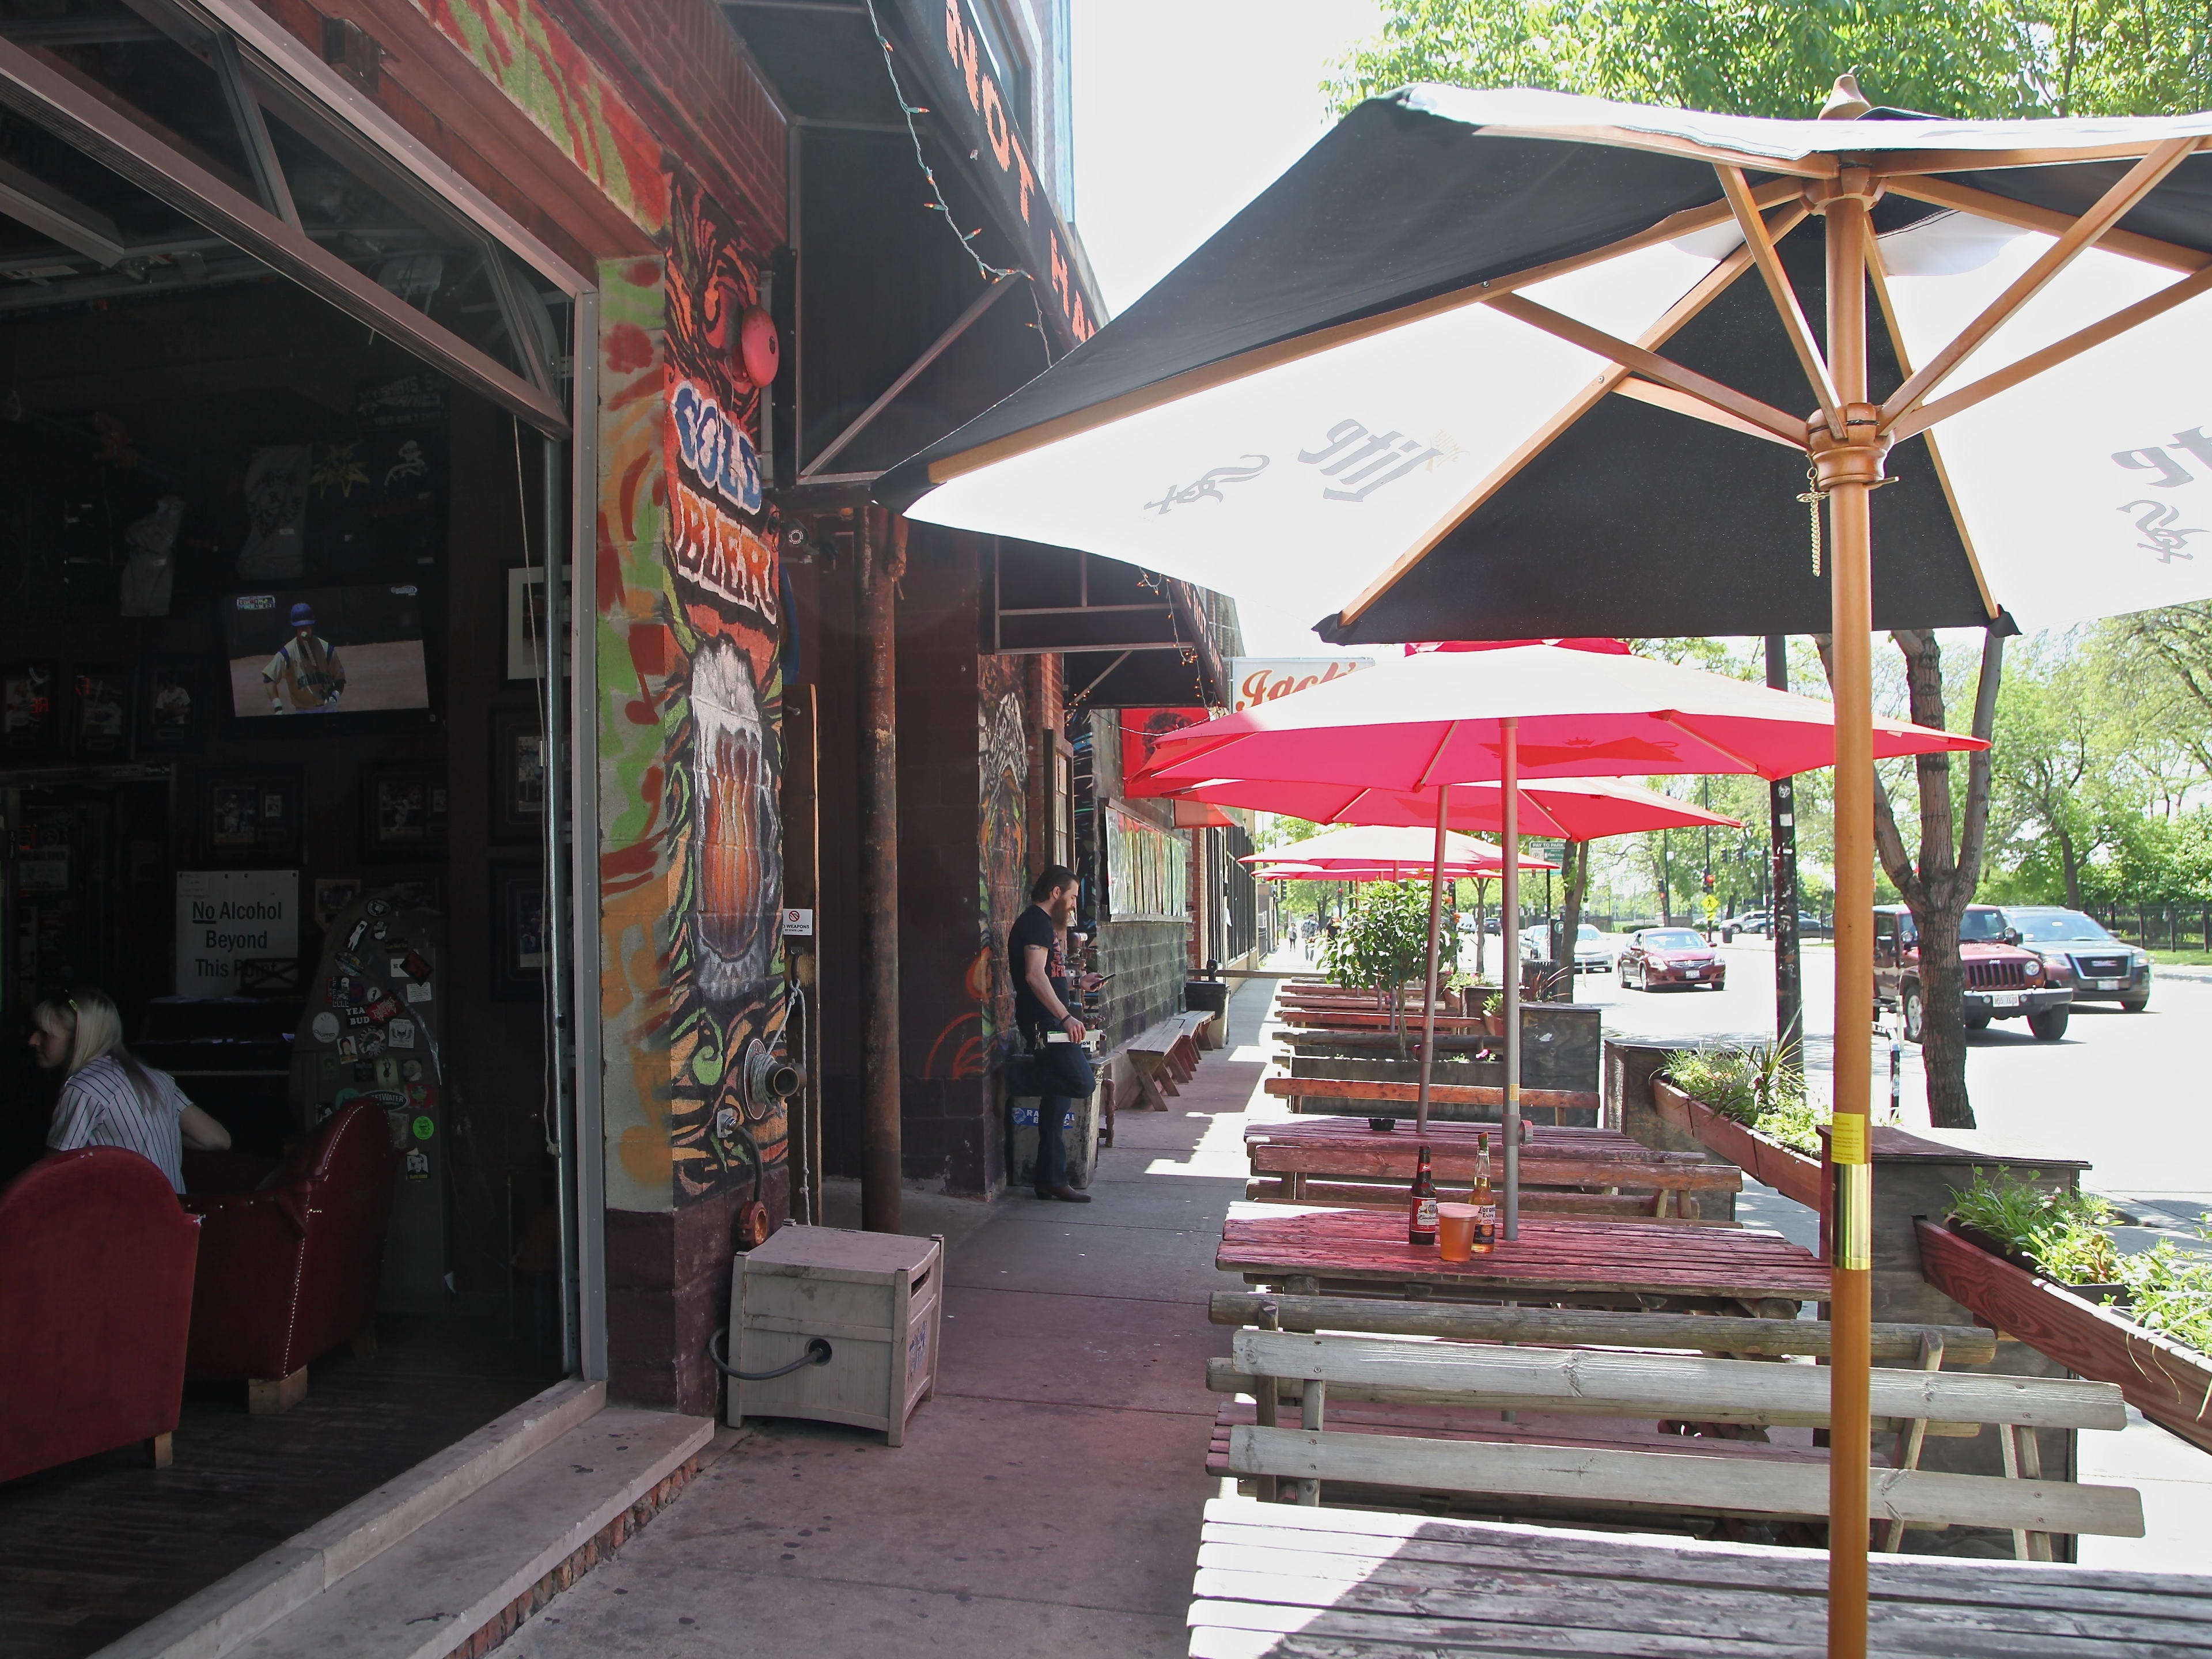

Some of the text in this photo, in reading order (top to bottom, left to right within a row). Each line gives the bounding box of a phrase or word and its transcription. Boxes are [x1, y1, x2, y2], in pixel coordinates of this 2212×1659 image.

[672, 380, 762, 515] COLD
[676, 482, 777, 624] BEER
[192, 901, 281, 922] No Alcohol
[206, 930, 267, 953] Beyond
[195, 959, 229, 978] This
[350, 1016, 370, 1025] BUD
